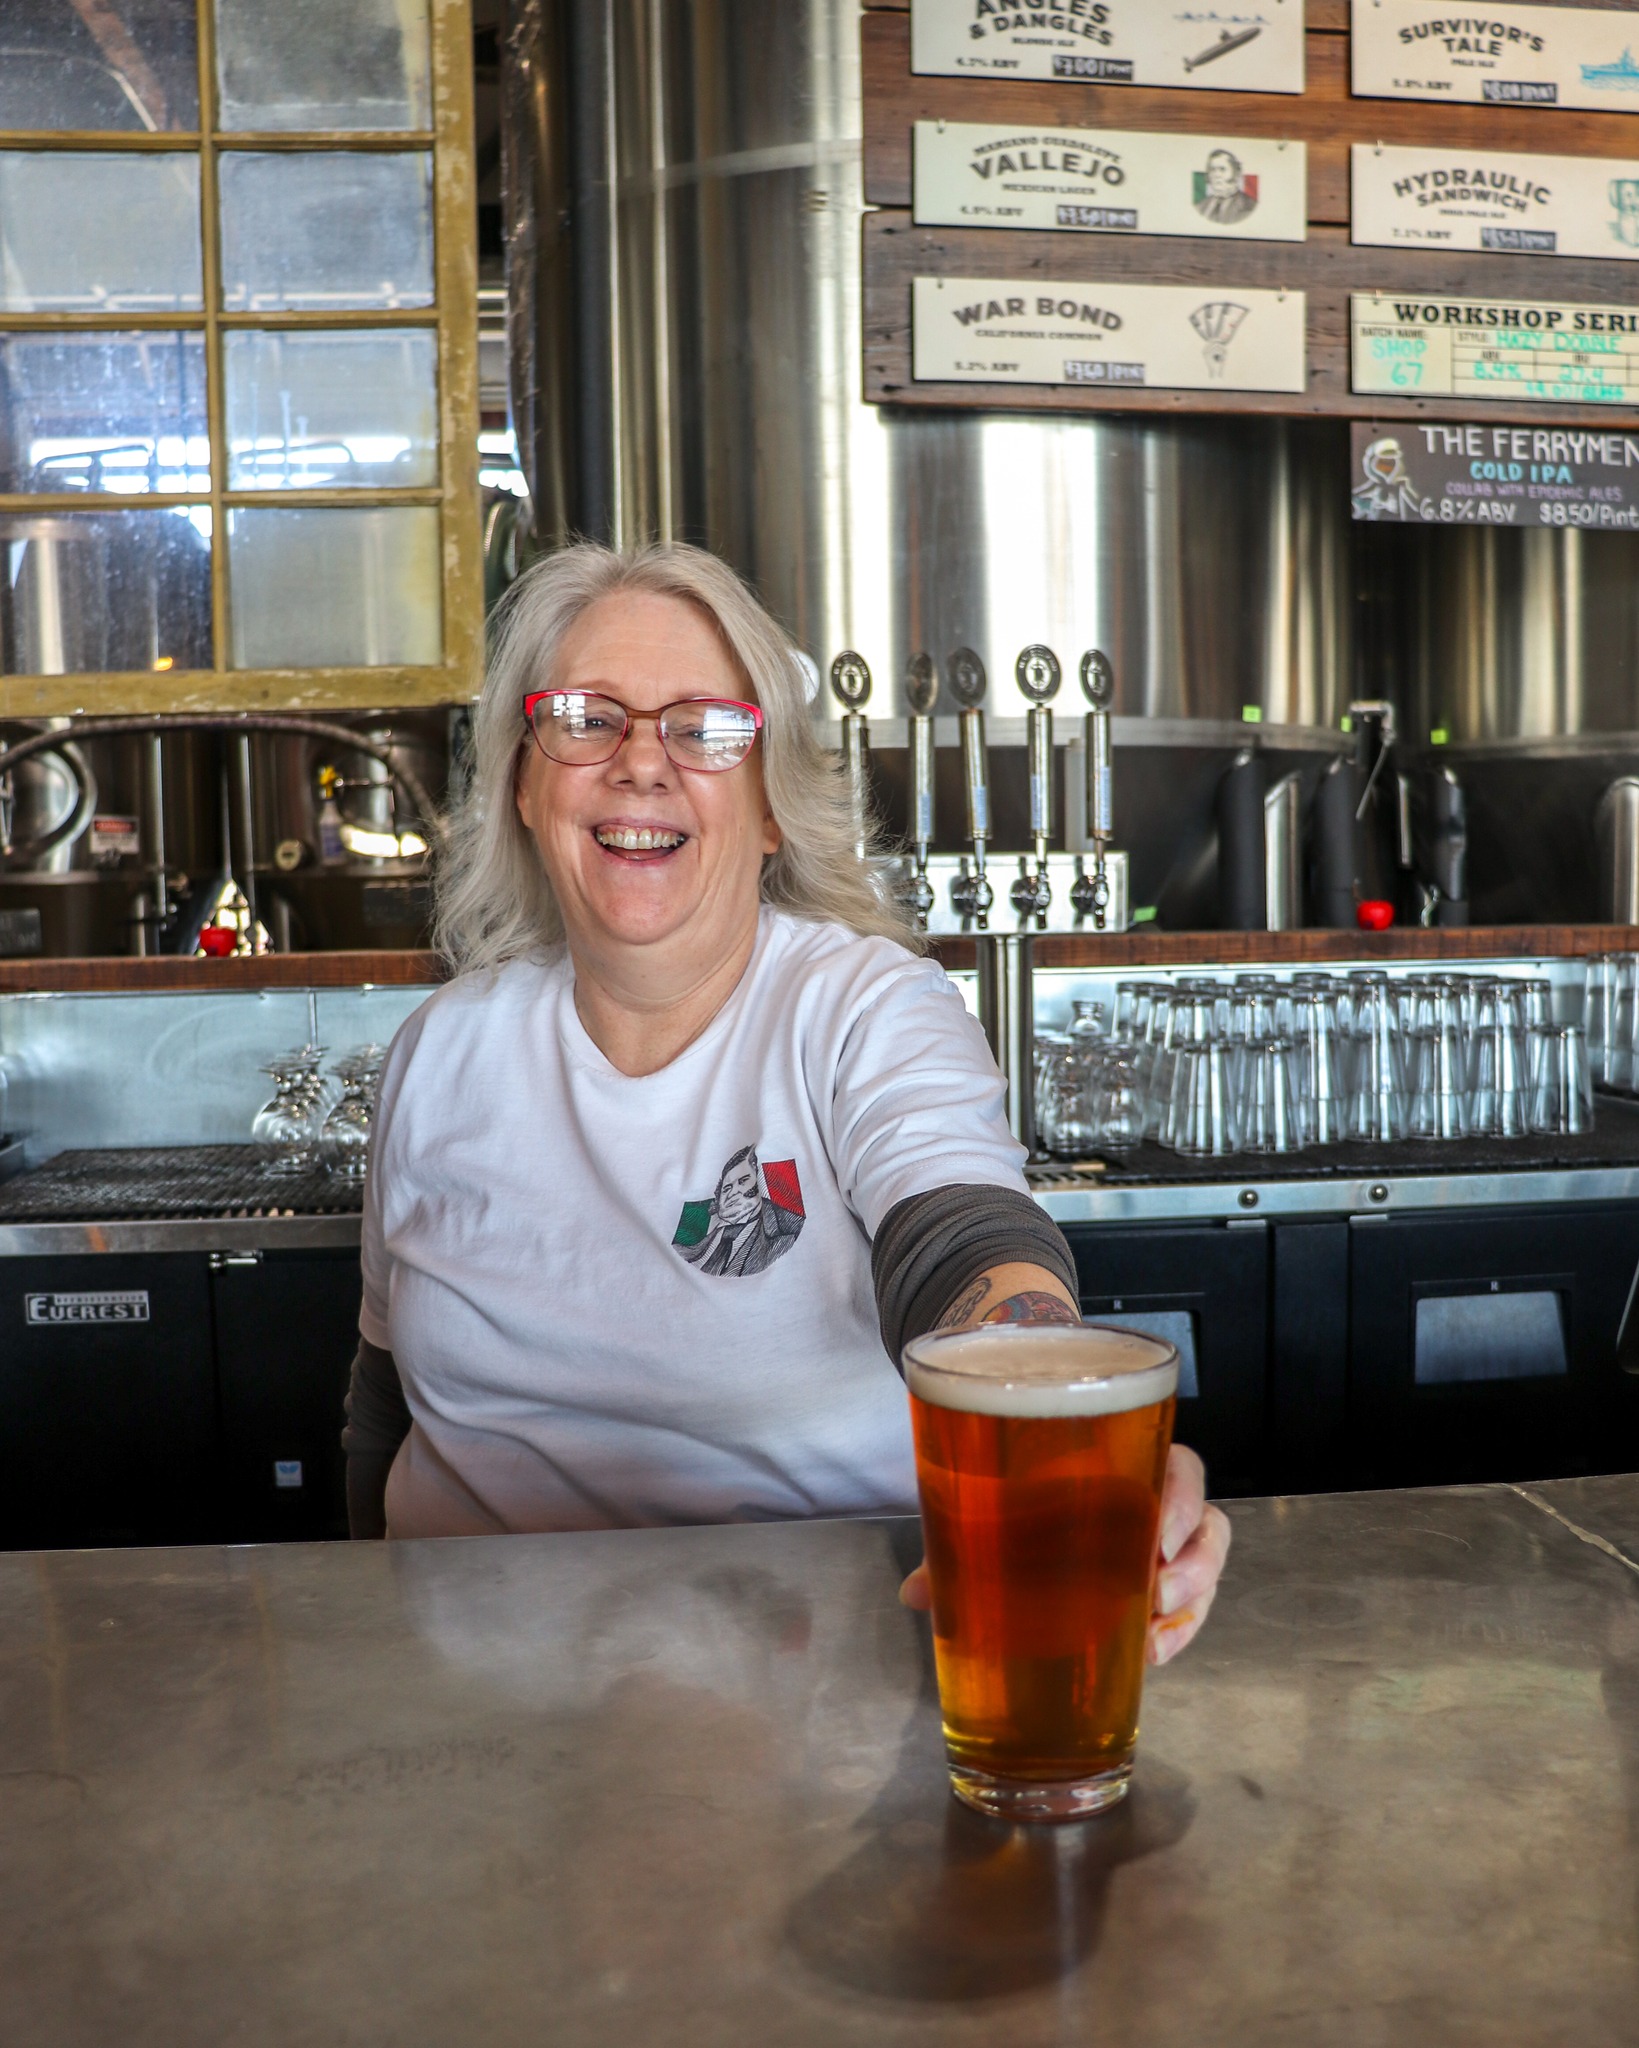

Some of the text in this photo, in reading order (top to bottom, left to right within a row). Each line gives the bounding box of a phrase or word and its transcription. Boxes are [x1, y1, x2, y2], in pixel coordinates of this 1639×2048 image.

[969, 13, 1114, 46] & DANGLES
[1398, 19, 1545, 52] SURVIVOR'S
[1442, 37, 1504, 56] TALE
[970, 151, 1125, 186] VALLEJO
[1393, 169, 1551, 205] HYDRAULIC
[1417, 188, 1528, 213] SANDWICH
[953, 298, 1122, 331] WAR BOND
[1394, 304, 1563, 330] WORKSHOP
[1370, 339, 1427, 359] SHOP
[1391, 362, 1424, 386] 67
[1419, 425, 1639, 467] THE FERRYMEN
[1470, 461, 1573, 484] COLD IPA
